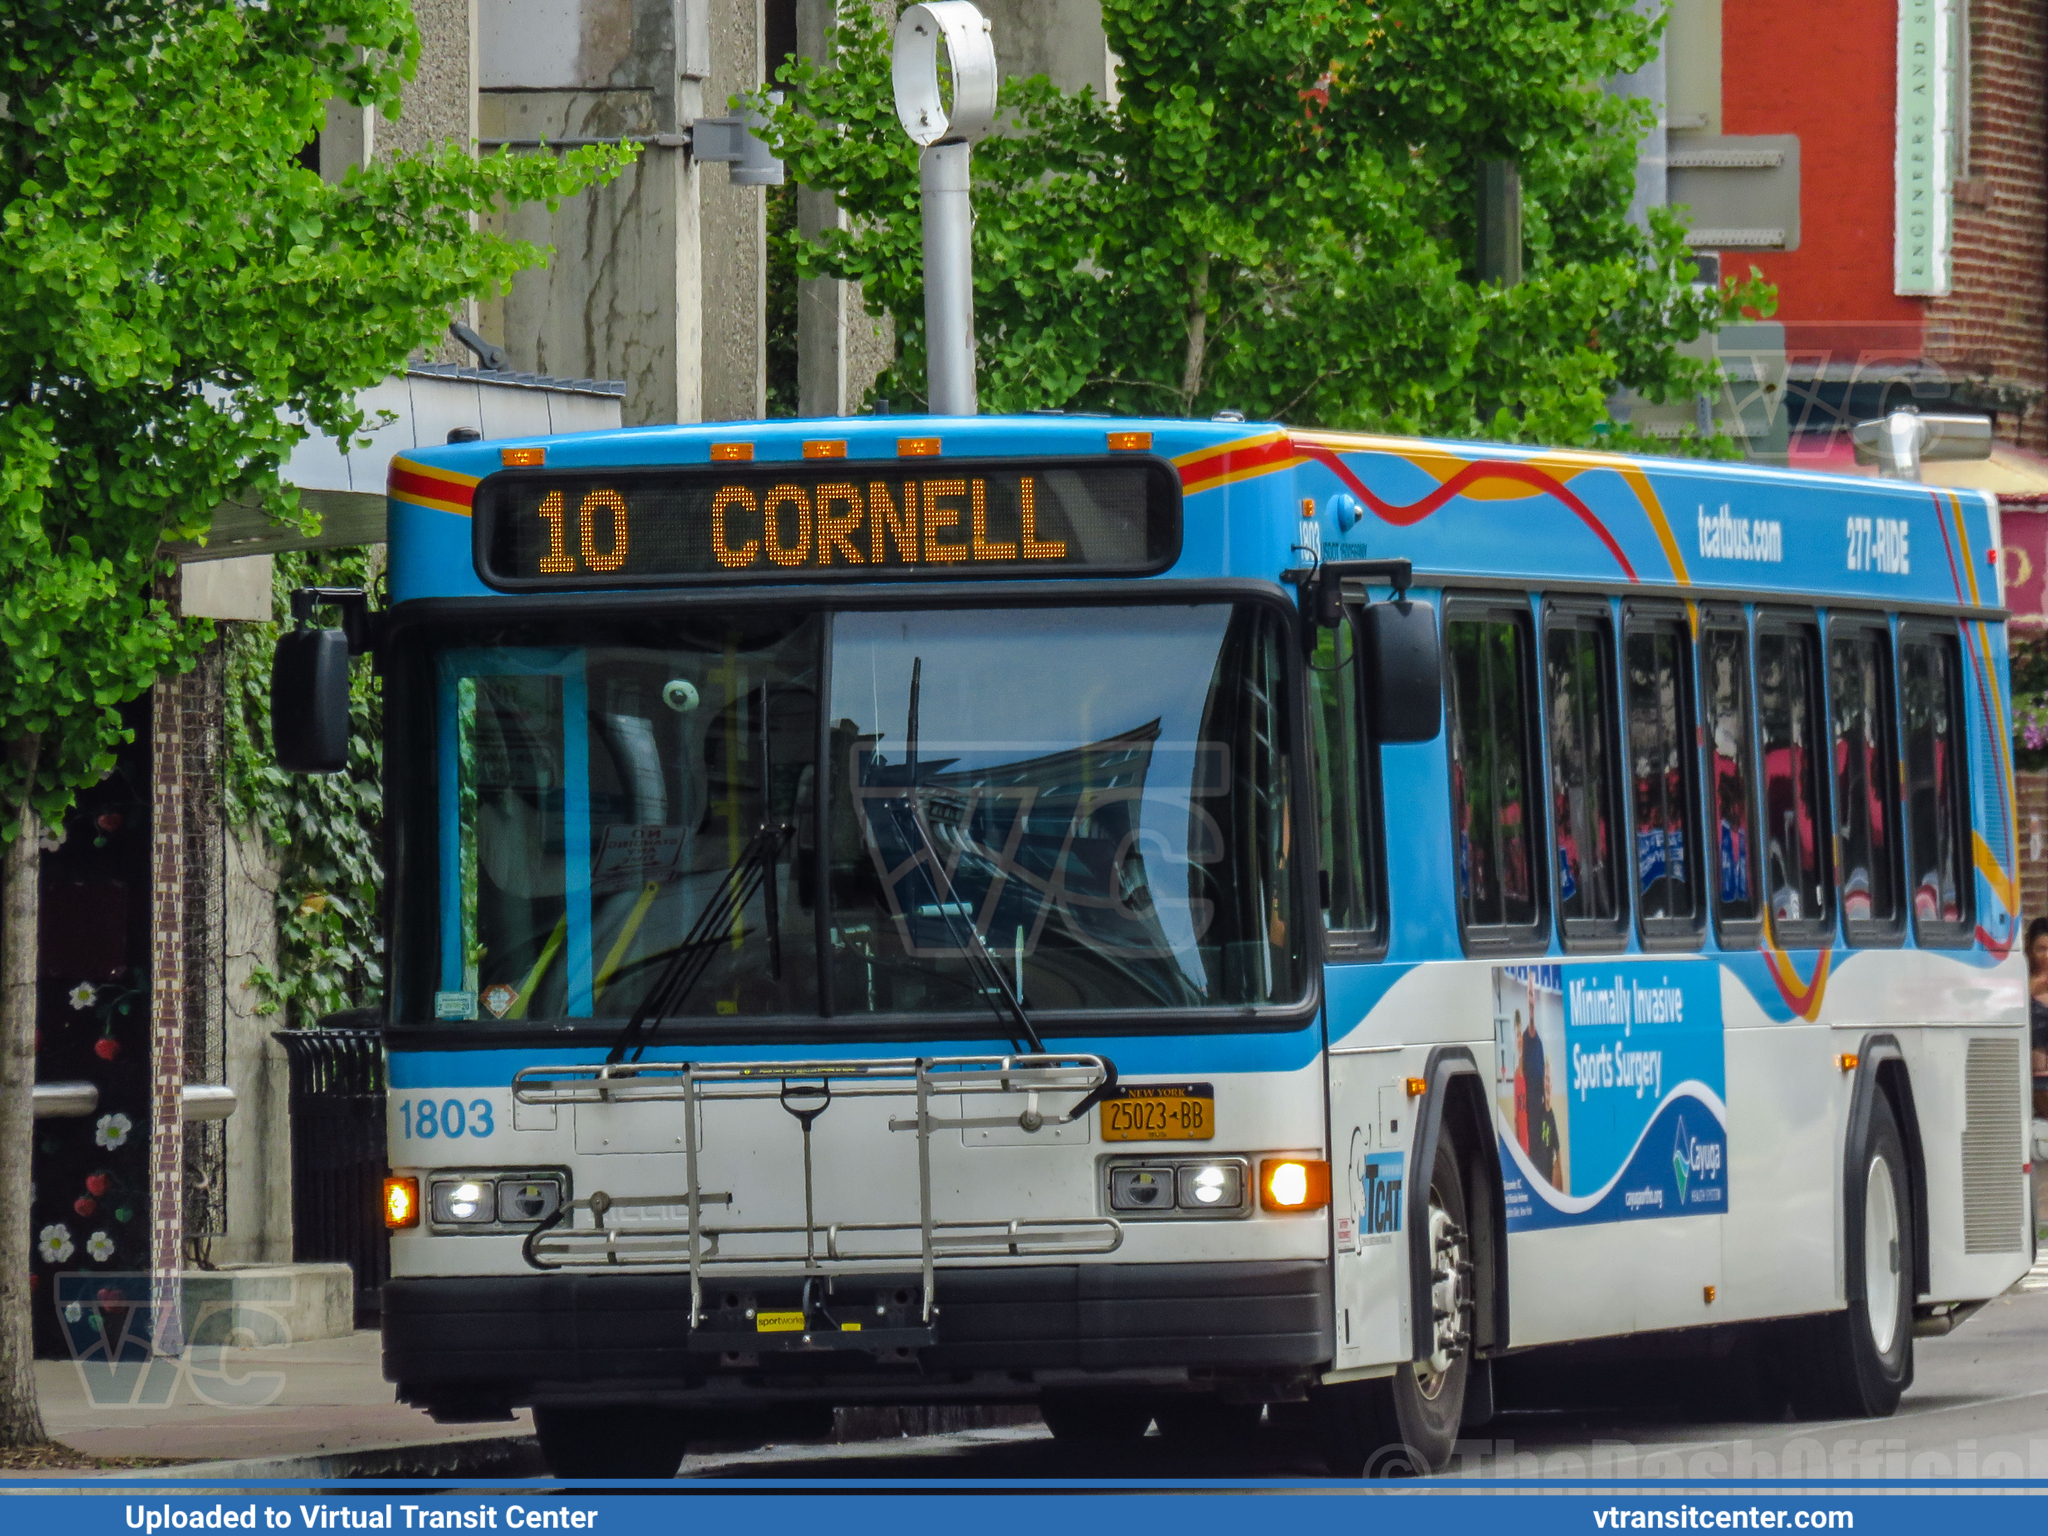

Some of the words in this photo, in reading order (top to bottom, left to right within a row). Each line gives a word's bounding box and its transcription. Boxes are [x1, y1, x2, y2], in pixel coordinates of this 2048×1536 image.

[1912, 42, 1926, 95] AND
[1910, 116, 1925, 275] ENGINEERS
[538, 489, 629, 573] 10
[711, 476, 1067, 569] CORNELL
[1299, 521, 1320, 562] 1803
[1698, 503, 1782, 562] tcatbus.com
[1847, 516, 1909, 575] 277-RIDE
[1569, 976, 1631, 1036] Minimally
[1633, 976, 1683, 1023] Invasive
[1128, 1089, 1155, 1098] NEW
[1157, 1088, 1186, 1098] YORK
[1573, 1043, 1613, 1101] Sports
[1616, 1041, 1662, 1099] Surgery
[400, 1098, 495, 1140] 1803
[1690, 1137, 1720, 1180] Cayuga
[758, 1317, 805, 1327] sportworks
